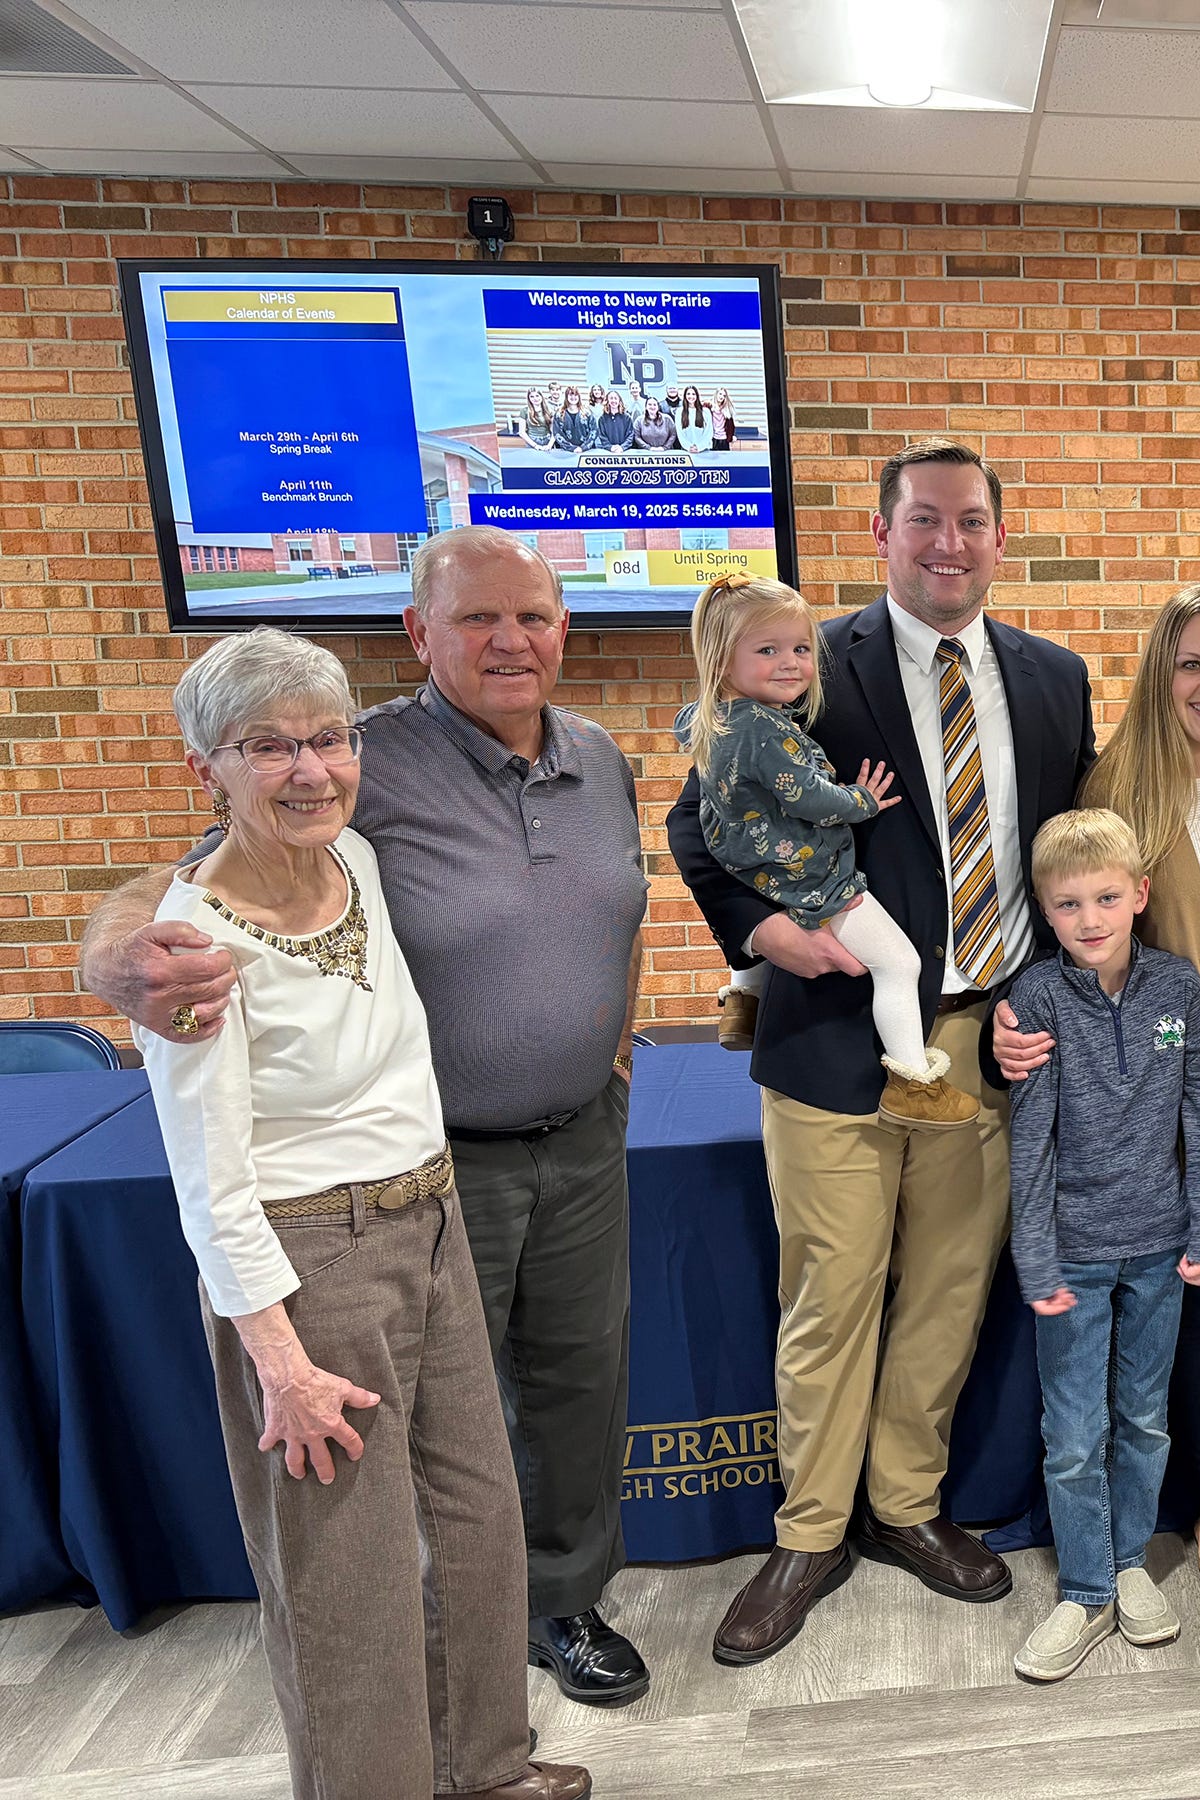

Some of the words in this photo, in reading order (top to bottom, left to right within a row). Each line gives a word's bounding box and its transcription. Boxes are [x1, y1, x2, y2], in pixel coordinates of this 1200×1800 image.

[484, 210, 493, 223] 1
[259, 292, 296, 304] NPHS
[528, 291, 600, 307] Welcome
[604, 293, 620, 307] to
[624, 293, 657, 307] New
[661, 293, 711, 308] Prairie
[226, 308, 279, 319] Calendar
[282, 308, 293, 319] of
[296, 308, 336, 320] Events
[577, 311, 611, 328] High
[617, 311, 671, 326] School
[239, 432, 274, 442] March
[277, 432, 301, 442] 29th
[312, 432, 339, 444] April
[341, 432, 359, 442] 6th
[270, 444, 301, 456] Spring
[303, 444, 332, 454] Break
[585, 456, 686, 465] CONGRATULATIONS
[544, 470, 592, 486] CLASS
[594, 470, 619, 485] OF
[622, 470, 660, 485] 2025
[664, 470, 697, 485] TOP
[699, 470, 730, 484] TEN
[280, 480, 306, 491] April
[309, 480, 333, 490] 11th
[262, 492, 317, 502] Benchmark
[318, 492, 353, 502] Brunch
[485, 505, 570, 520] Wednesday,
[574, 505, 617, 518] March
[621, 505, 642, 518] 19,
[646, 504, 679, 517] 2025
[682, 504, 733, 517] 5:56:44
[737, 504, 758, 516] PM
[674, 553, 703, 565] Until
[706, 553, 748, 567] Spring
[613, 561, 640, 574] 08d
[696, 570, 731, 581] Brea
[652, 1420, 777, 1465] PRAIR
[663, 1463, 781, 1499] SCHOOL
